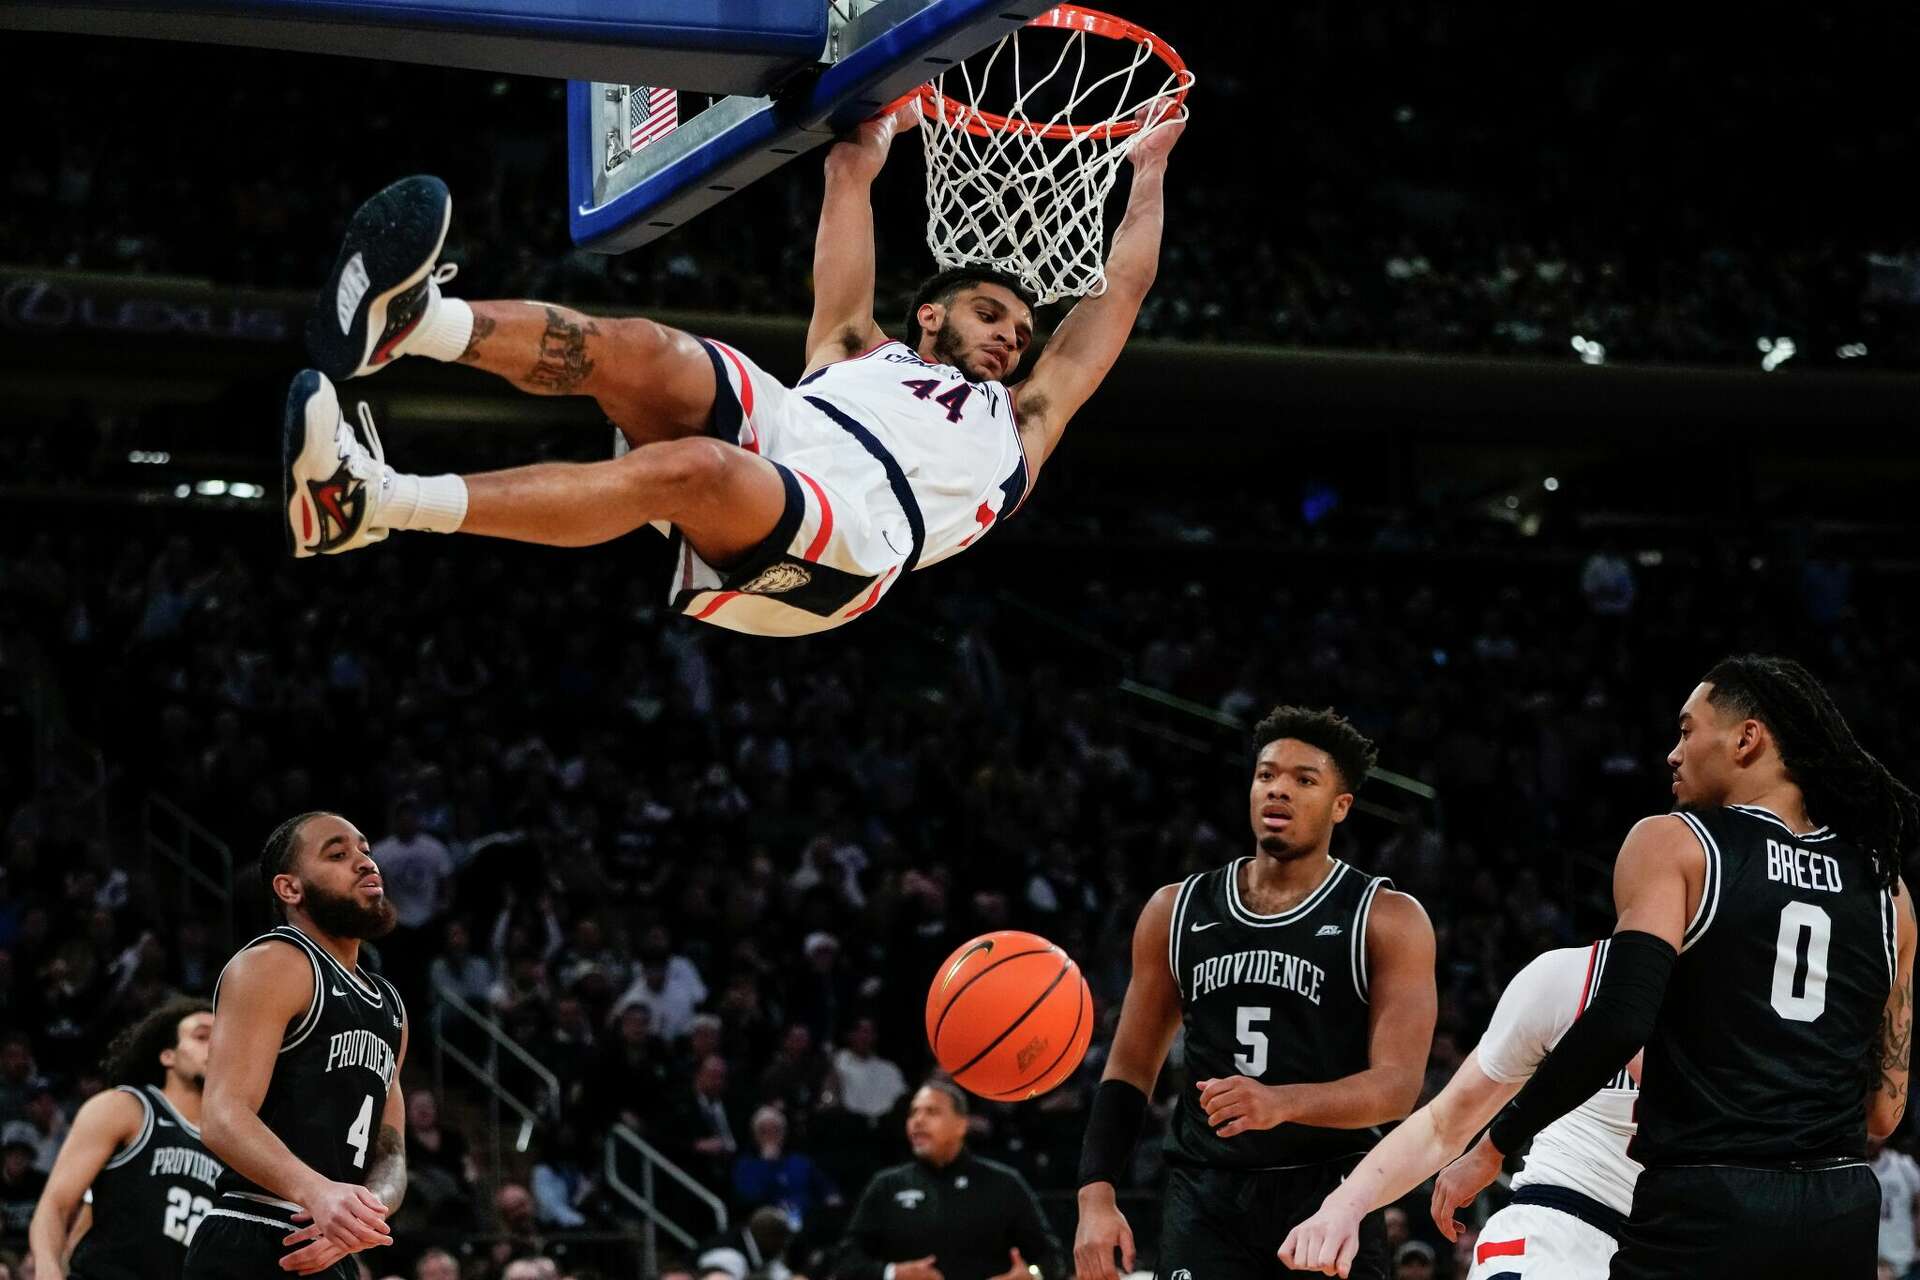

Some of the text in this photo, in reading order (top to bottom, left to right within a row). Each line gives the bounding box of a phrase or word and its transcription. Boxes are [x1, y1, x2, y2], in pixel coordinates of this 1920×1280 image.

[901, 379, 973, 424] 44
[1766, 838, 1843, 893] BREED
[1191, 950, 1325, 1005] PROVIDENCE
[1770, 900, 1831, 1023] 0
[1233, 1006, 1271, 1077] 5
[346, 1094, 374, 1169] 4
